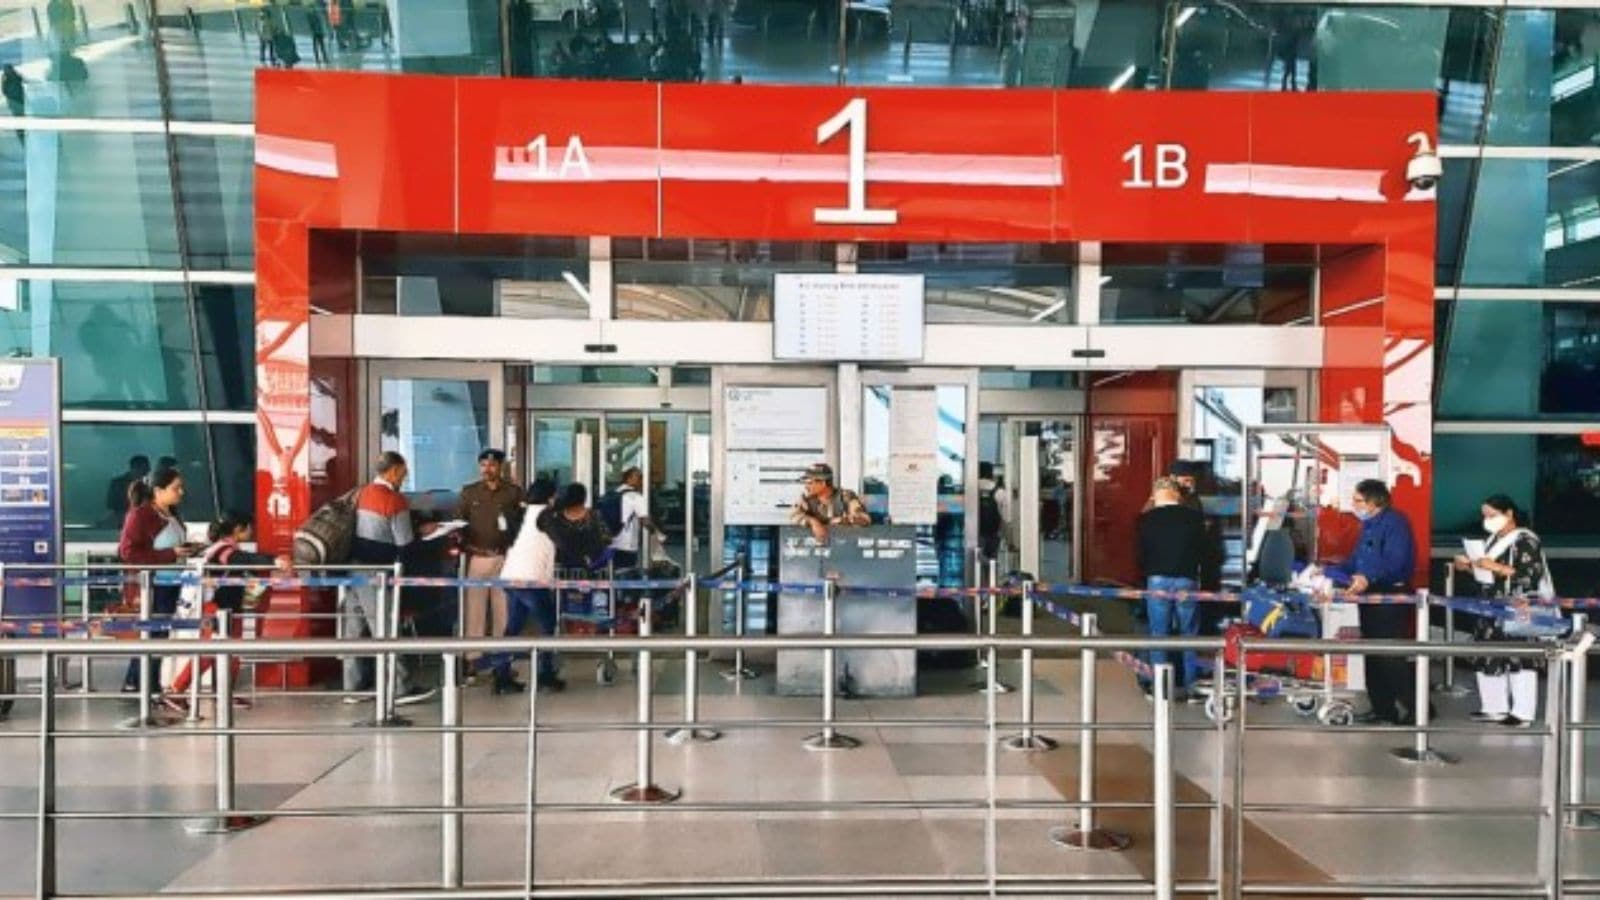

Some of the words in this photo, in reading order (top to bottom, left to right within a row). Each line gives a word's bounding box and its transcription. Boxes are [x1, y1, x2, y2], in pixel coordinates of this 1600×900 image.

[526, 133, 592, 178] 1A
[814, 98, 898, 224] 1
[1122, 144, 1189, 188] 1B
